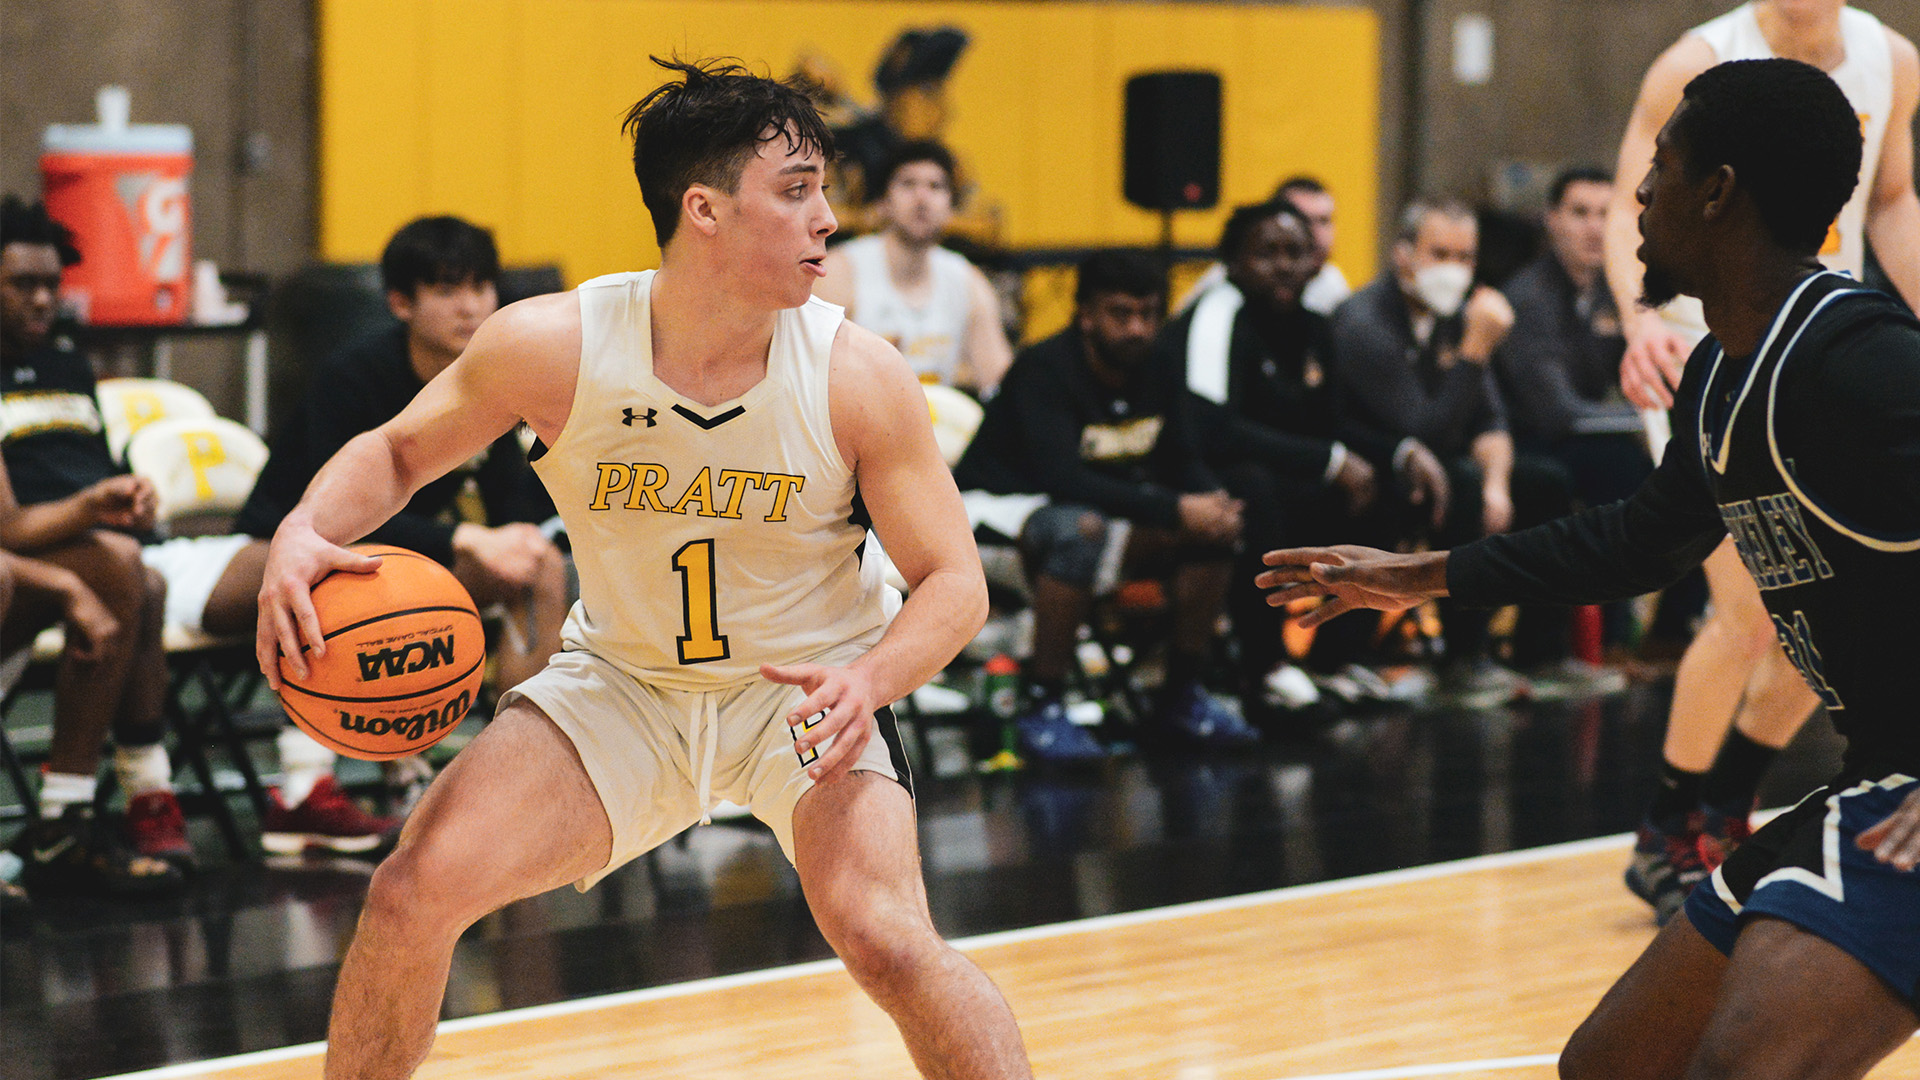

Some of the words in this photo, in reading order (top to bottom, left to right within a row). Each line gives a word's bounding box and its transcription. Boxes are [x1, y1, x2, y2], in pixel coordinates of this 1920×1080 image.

[181, 431, 226, 499] P
[589, 462, 806, 523] PRATT
[671, 537, 731, 665] 1
[356, 639, 384, 648] BALL
[357, 634, 455, 682] NCAA
[338, 688, 471, 742] Wilson
